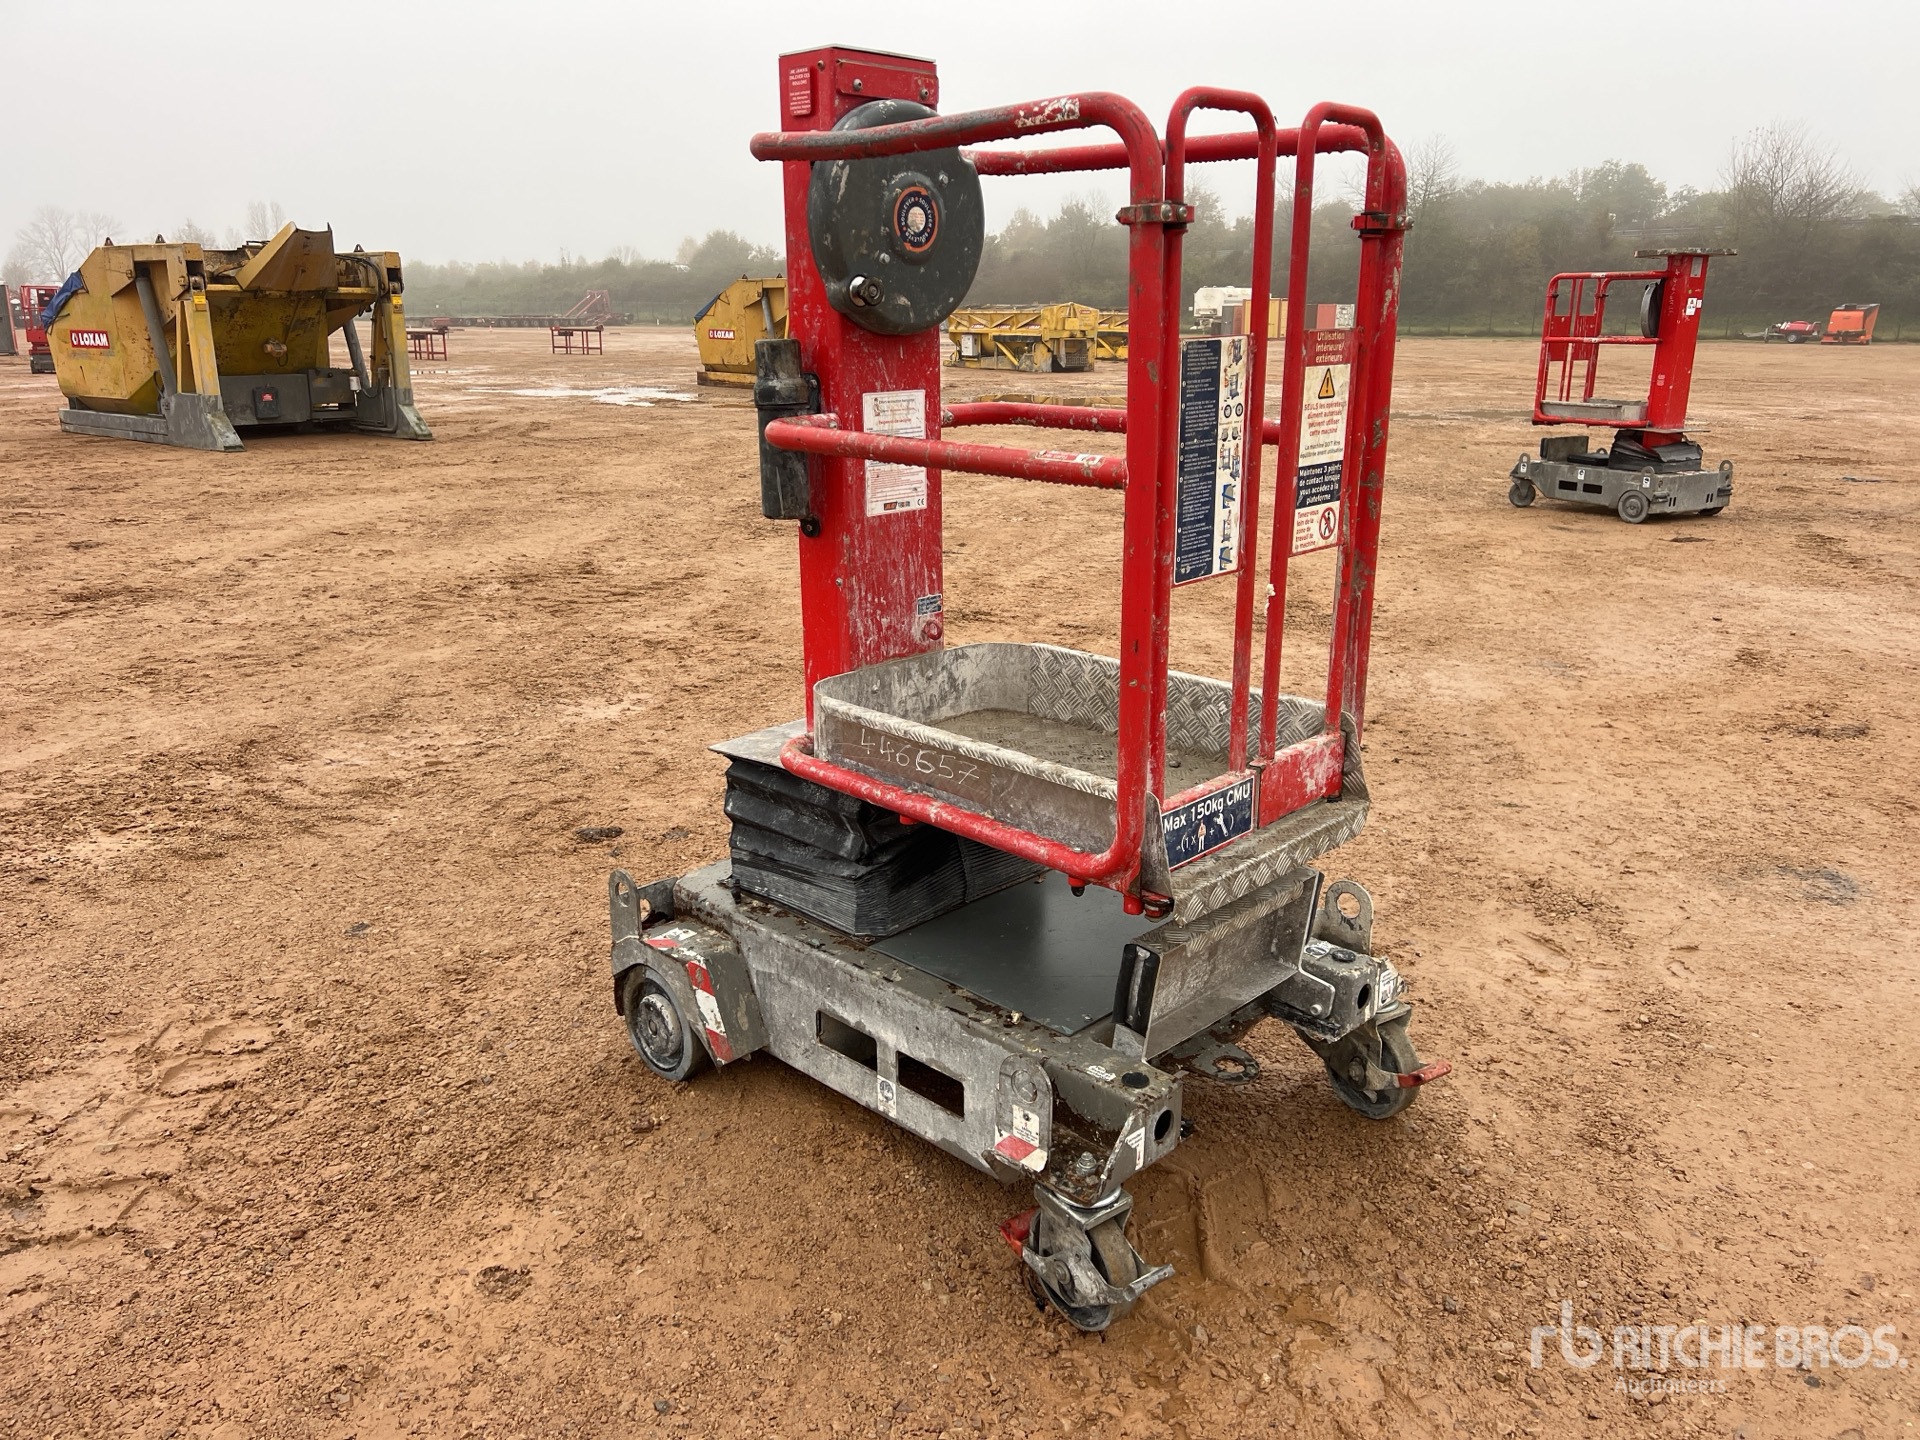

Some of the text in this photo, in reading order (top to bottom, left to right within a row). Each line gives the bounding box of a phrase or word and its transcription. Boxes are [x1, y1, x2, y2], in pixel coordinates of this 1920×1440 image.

[78, 332, 109, 347] LOXAM
[714, 330, 734, 339] LOXAM
[1317, 330, 1345, 341] Utilisation
[1315, 353, 1343, 364] extérieure
[1299, 463, 1342, 477] Maintenez 3 points
[1299, 473, 1341, 487] de contact lorsque
[1311, 484, 1331, 494] accédez
[1306, 494, 1331, 506] plateforme
[861, 728, 980, 785] 446657
[1164, 782, 1251, 834] Max 150kg CMU
